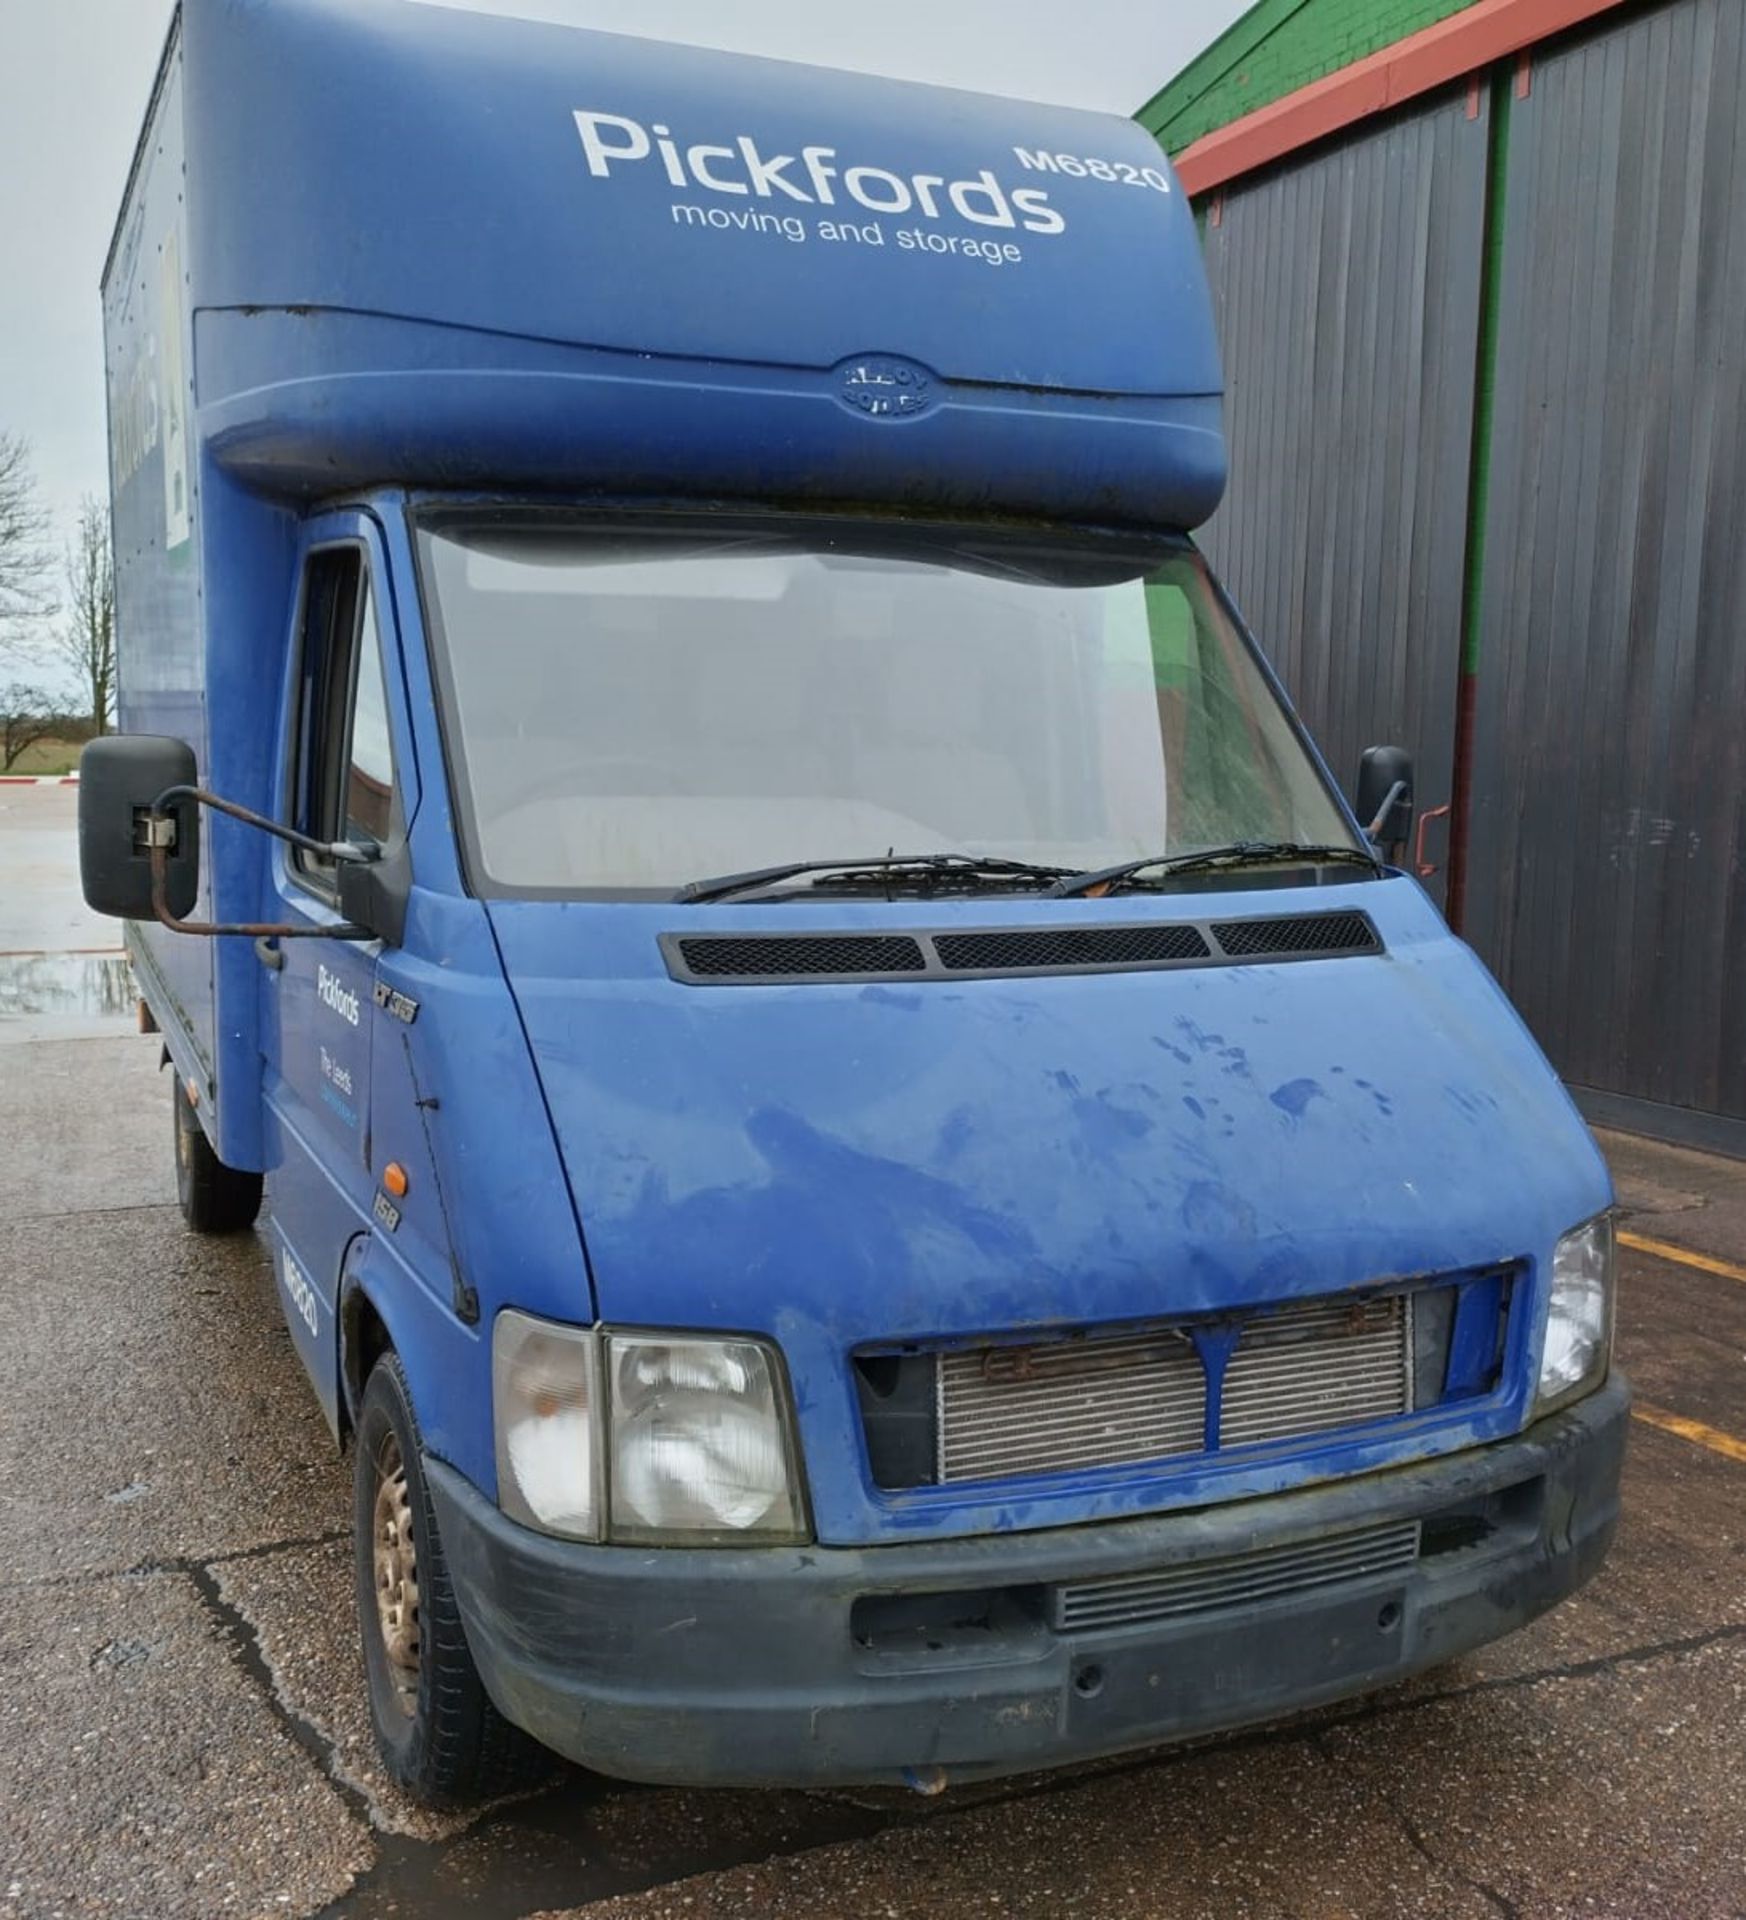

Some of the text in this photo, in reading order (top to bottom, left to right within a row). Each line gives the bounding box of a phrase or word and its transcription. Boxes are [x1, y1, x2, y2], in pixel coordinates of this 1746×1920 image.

[573, 110, 1066, 235] Pickfords
[1013, 146, 1171, 194] M6820
[672, 204, 1022, 267] moving and storage
[318, 963, 359, 1027] Pickfords
